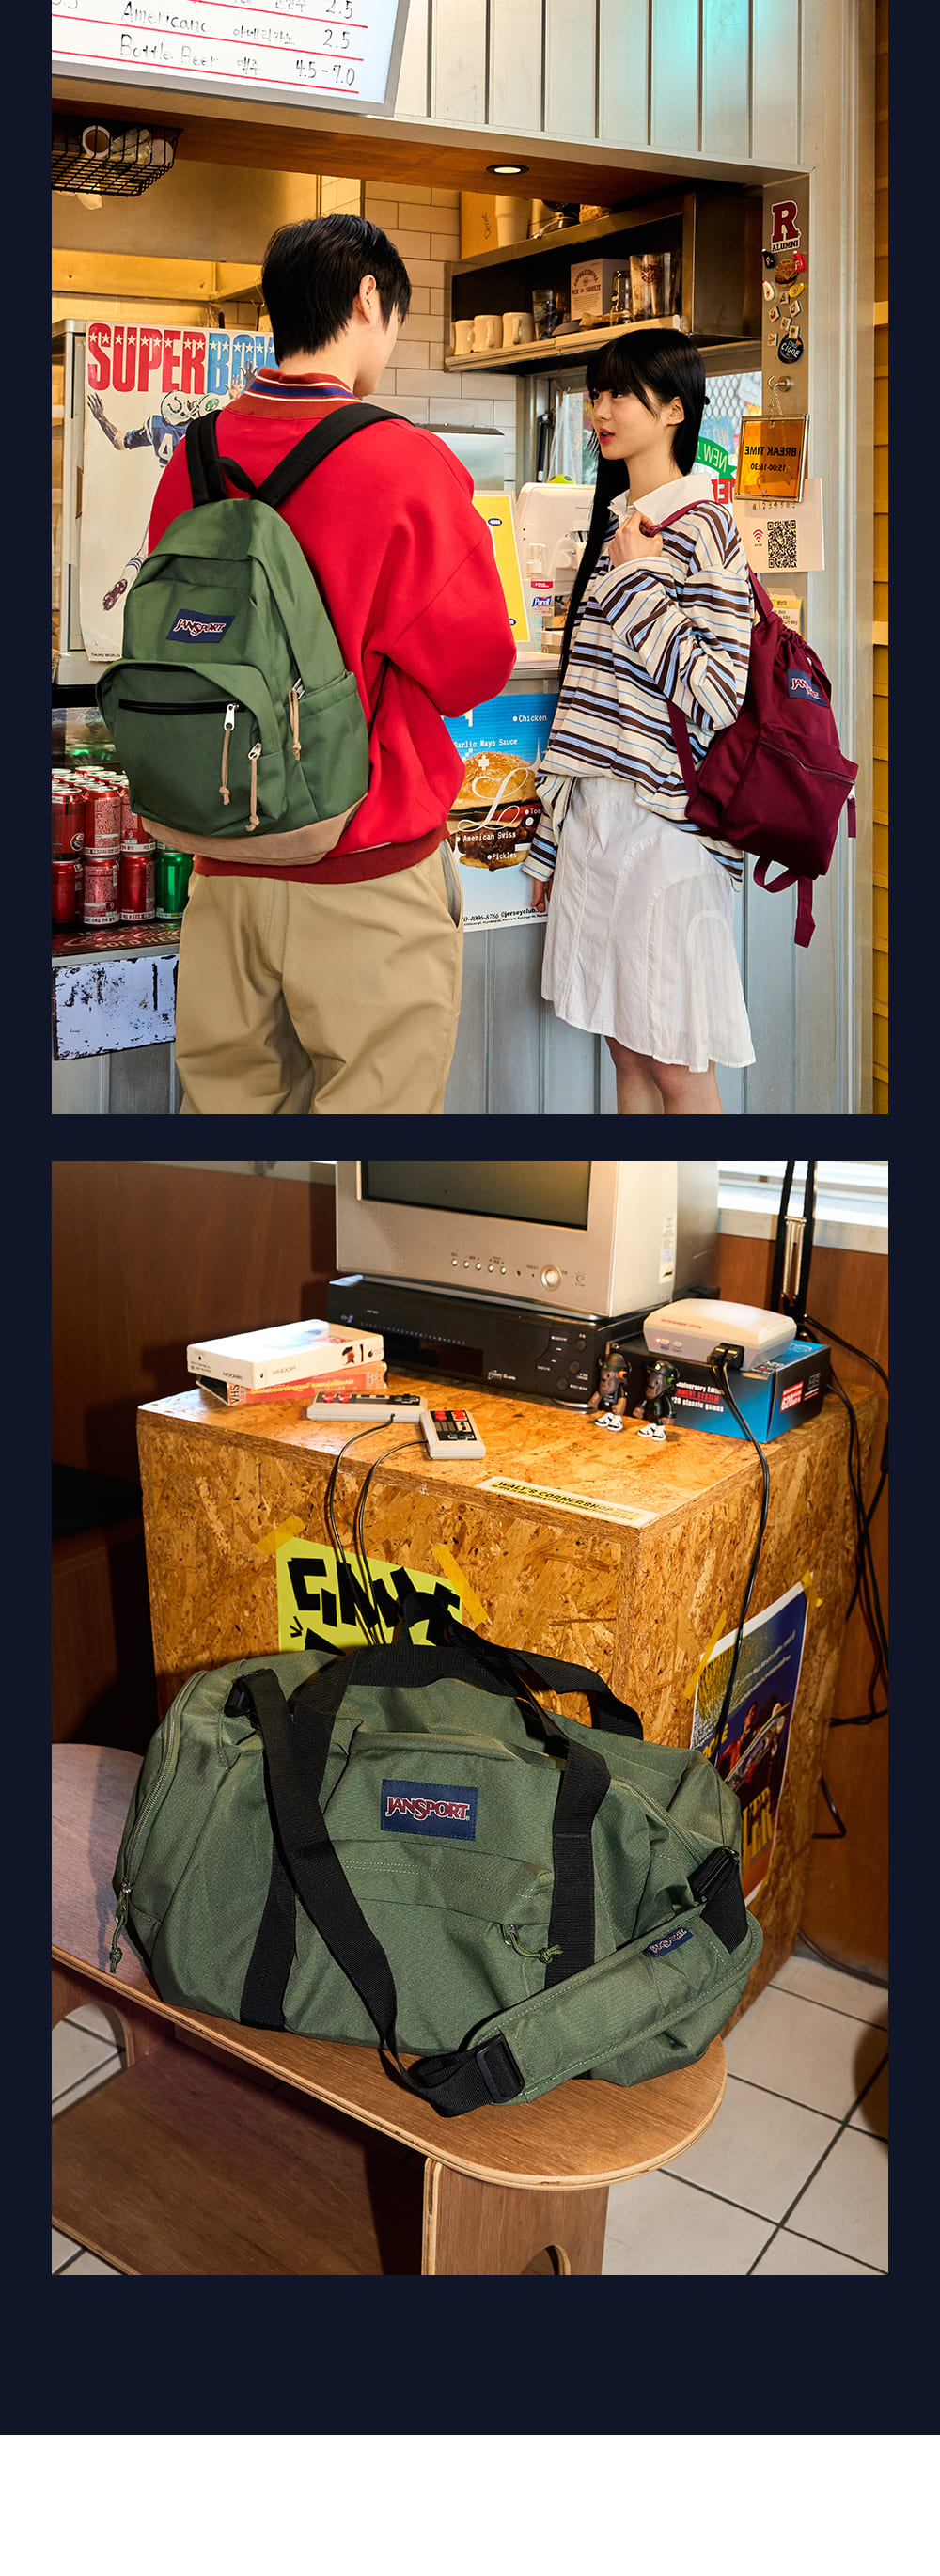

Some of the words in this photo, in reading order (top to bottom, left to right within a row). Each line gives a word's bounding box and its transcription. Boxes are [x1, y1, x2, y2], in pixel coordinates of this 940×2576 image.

[121, 1, 211, 33] Americano
[322, 28, 351, 50] 2.5
[120, 34, 173, 60] Bottle
[181, 45, 219, 68] Beer
[771, 200, 801, 244] R
[772, 240, 799, 252] ALUMNI
[87, 322, 206, 395] SUPER
[173, 618, 226, 636] JANSPORT
[518, 714, 547, 723] Chicken
[453, 740, 478, 749] Garlic
[479, 739, 496, 748] Mayo
[530, 807, 541, 815] Tom
[462, 833, 495, 842] American
[497, 831, 517, 840] Swiss
[492, 851, 517, 860] Pickles
[385, 1797, 470, 1821] JANSPORT
